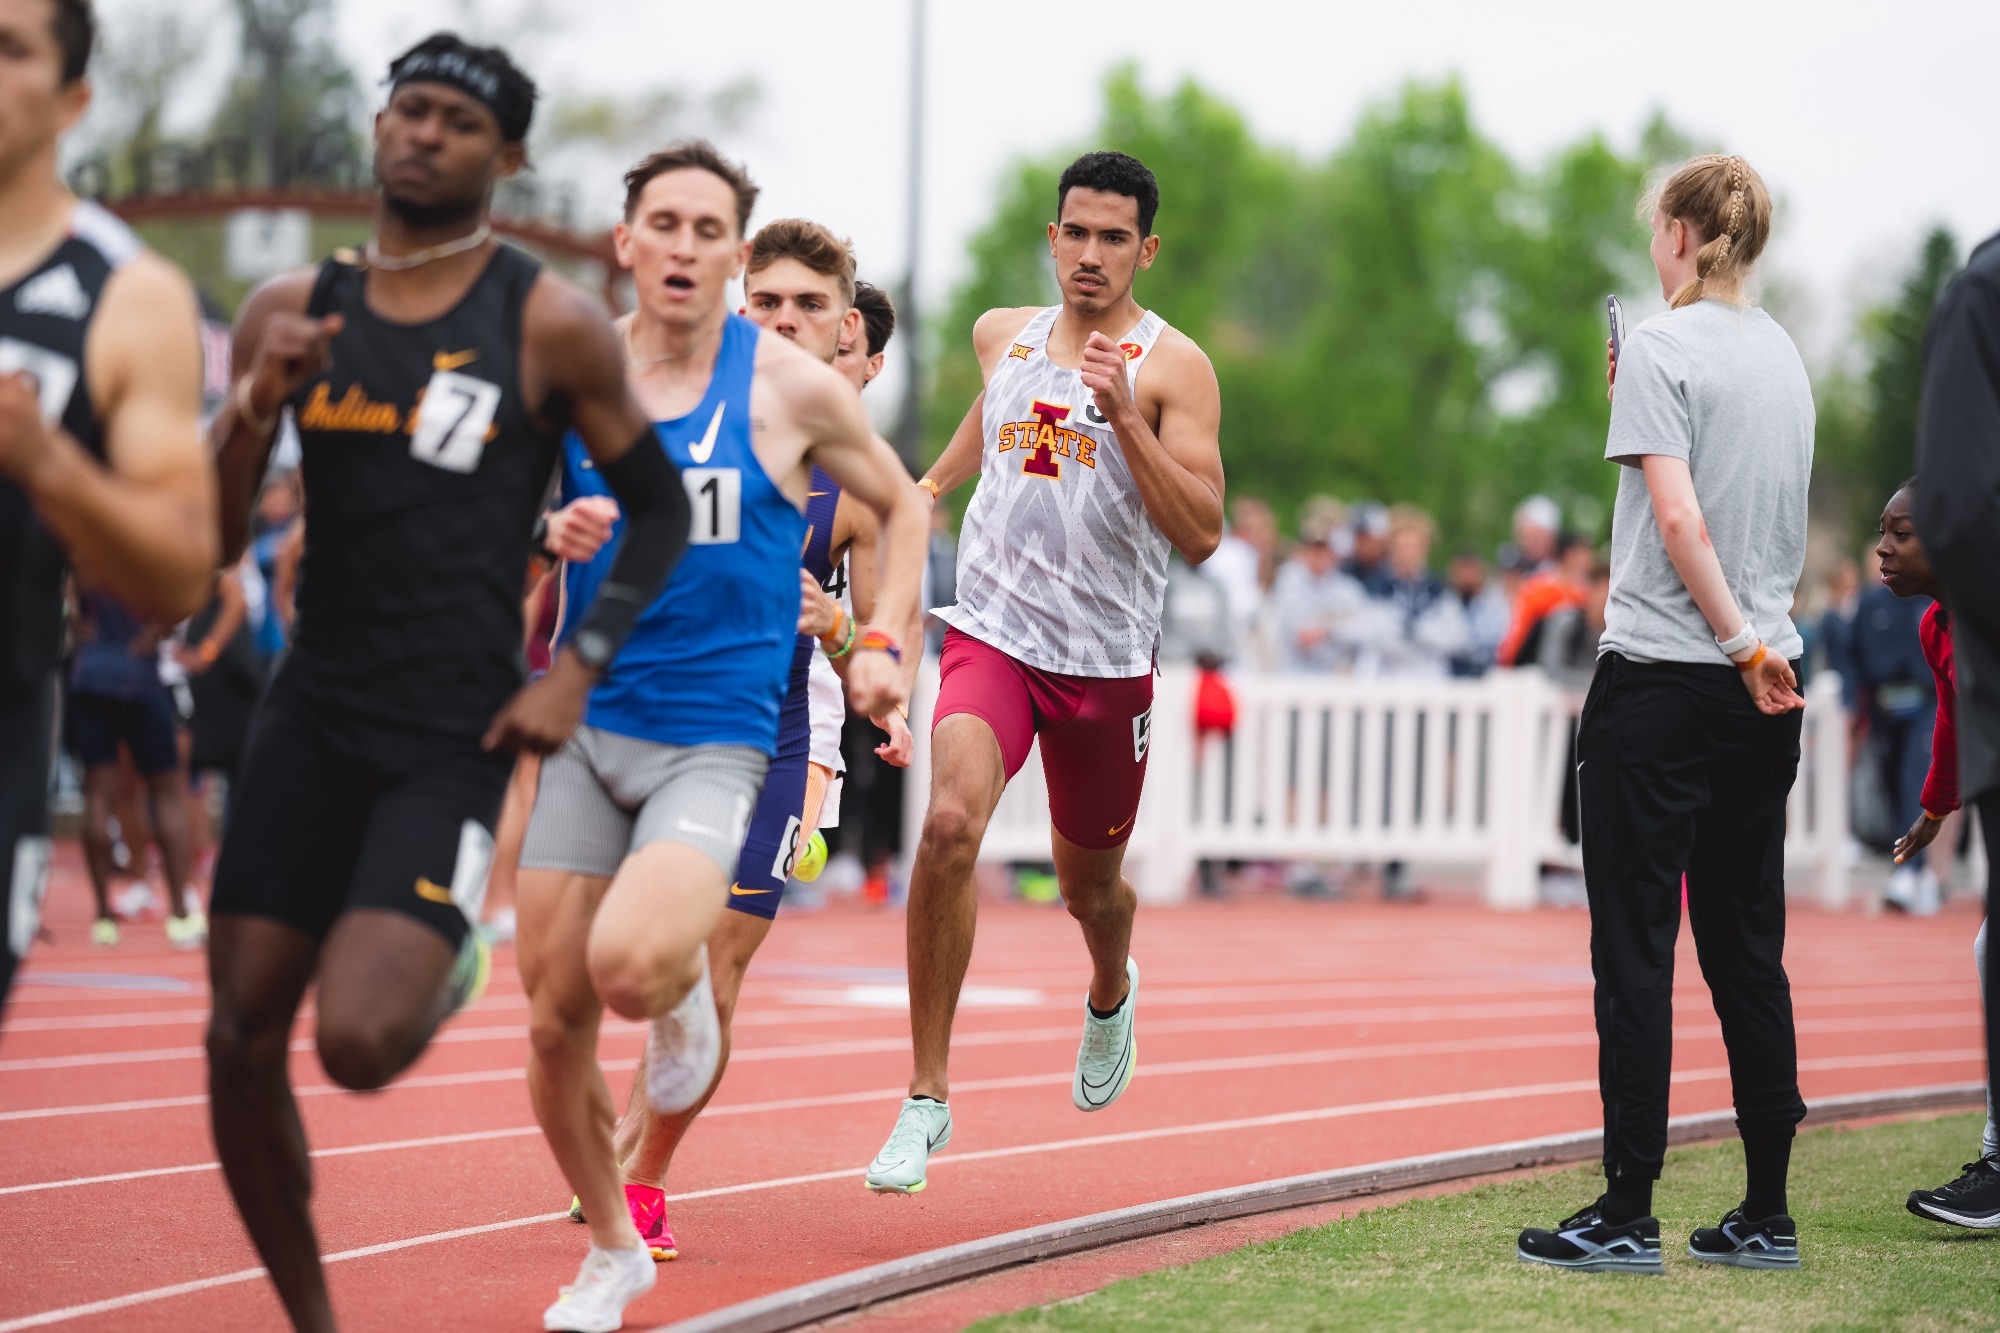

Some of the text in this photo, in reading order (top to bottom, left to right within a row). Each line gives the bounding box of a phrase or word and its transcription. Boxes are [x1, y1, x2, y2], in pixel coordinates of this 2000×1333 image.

[436, 386, 477, 456] 7
[999, 421, 1097, 469] STATE
[700, 477, 719, 538] 1
[821, 561, 848, 600] 4
